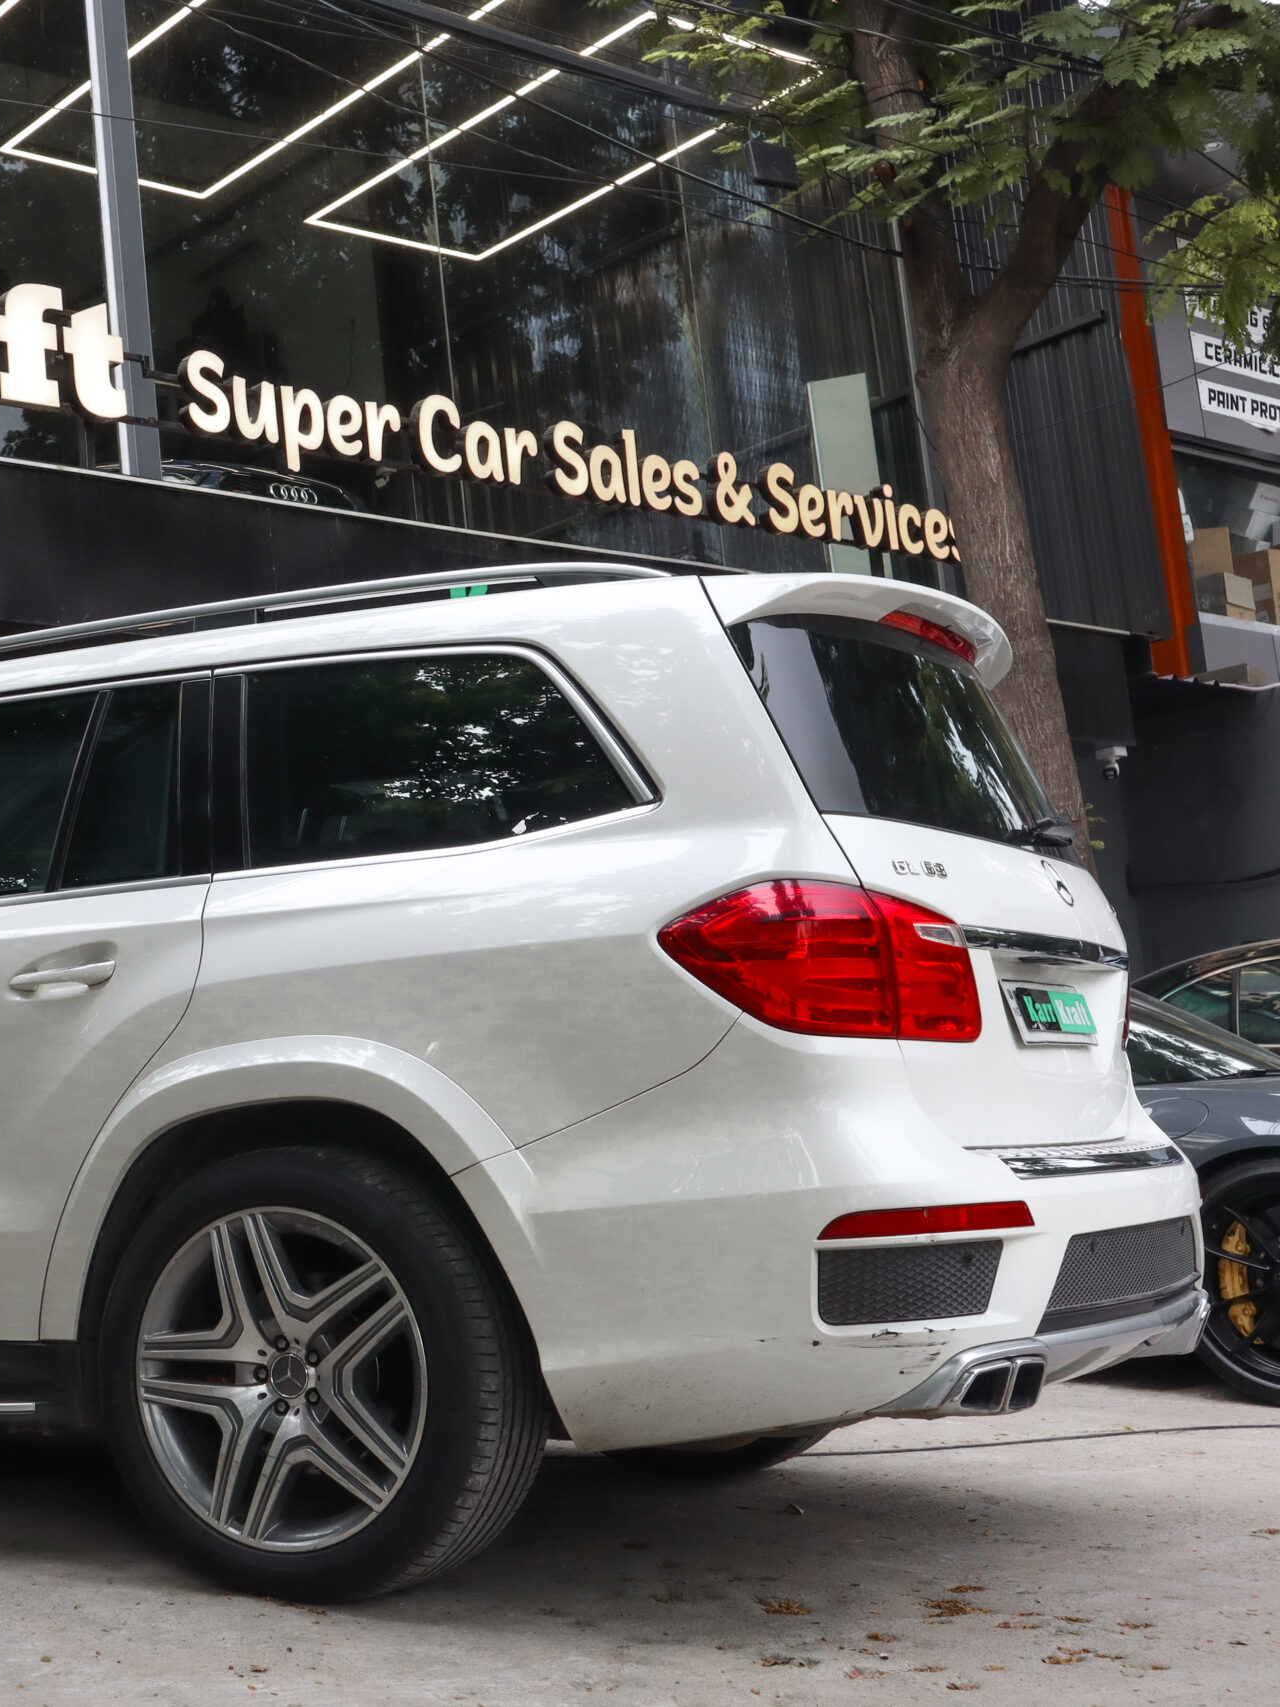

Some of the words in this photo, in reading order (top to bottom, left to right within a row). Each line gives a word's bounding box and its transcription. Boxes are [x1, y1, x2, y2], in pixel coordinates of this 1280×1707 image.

[1208, 387, 1247, 413] PAINT
[180, 349, 401, 471] Super
[413, 394, 538, 484] Car
[548, 420, 702, 516] Sales
[710, 450, 756, 527] &
[762, 463, 961, 562] Service
[1023, 995, 1057, 1022] Karr
[1054, 999, 1091, 1026] Kraft
